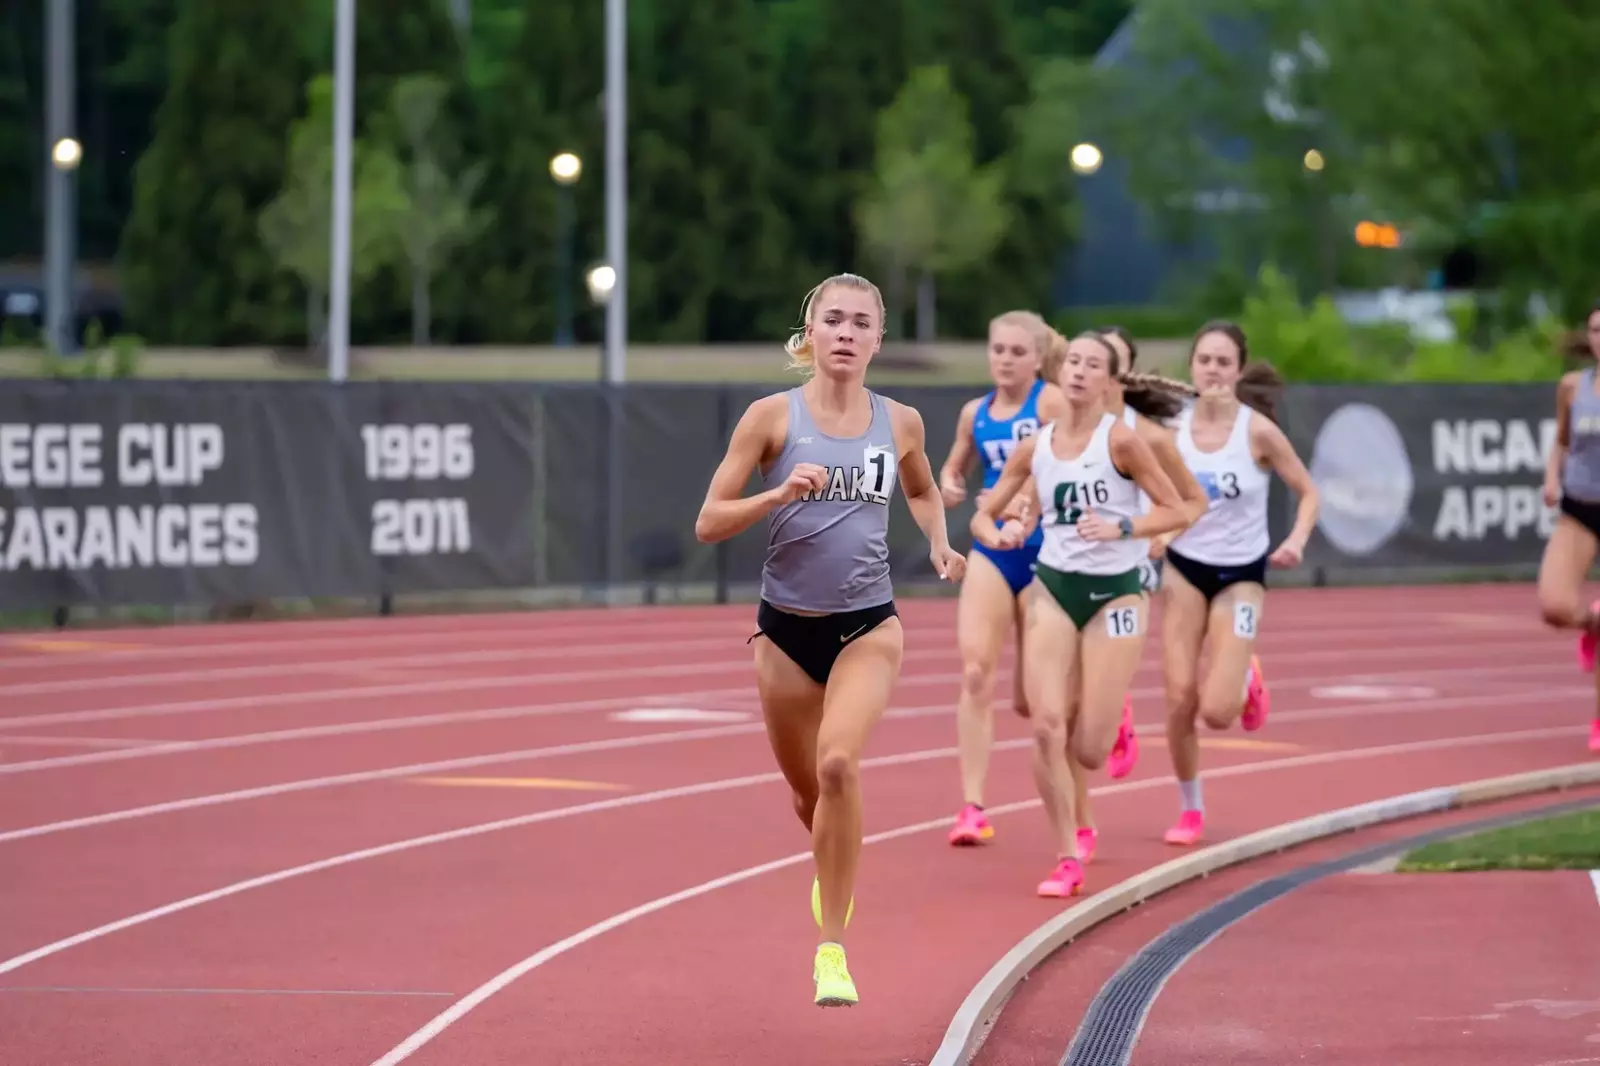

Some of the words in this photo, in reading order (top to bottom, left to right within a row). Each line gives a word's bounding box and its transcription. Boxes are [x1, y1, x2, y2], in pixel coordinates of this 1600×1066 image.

[0, 423, 103, 487] EGE
[118, 423, 224, 486] CUP
[361, 423, 474, 480] 1996
[801, 466, 887, 505] AK
[870, 453, 885, 492] 1
[1222, 472, 1240, 499] 3
[1080, 480, 1108, 505] 16
[0, 503, 259, 570] ARANCES
[371, 498, 471, 555] 2011
[1109, 608, 1133, 634] 16
[1240, 606, 1253, 633] 3
